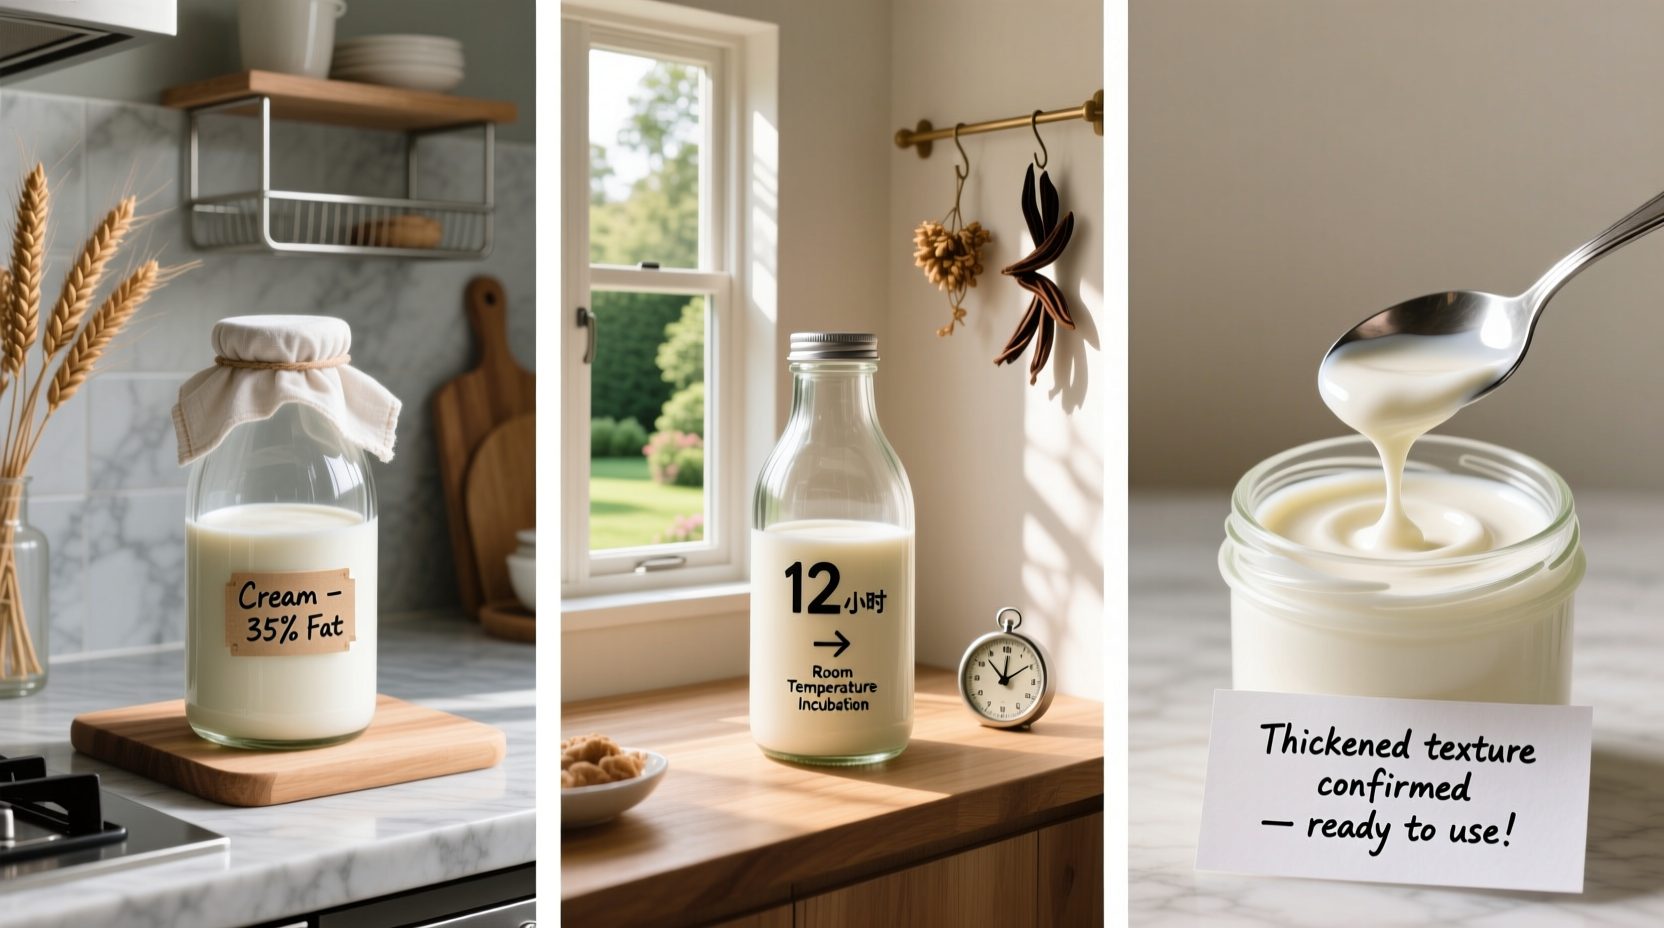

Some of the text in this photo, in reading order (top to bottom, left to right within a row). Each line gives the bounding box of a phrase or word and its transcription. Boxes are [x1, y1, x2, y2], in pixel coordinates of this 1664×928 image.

[238, 580, 318, 610] Cream
[246, 613, 344, 645] 35% Fat
[812, 664, 854, 679] Room
[786, 679, 878, 698] Temperature
[798, 696, 870, 712] Incubation
[1260, 722, 1537, 764] Thickened texture
[1317, 767, 1472, 804] confirmed
[1307, 809, 1391, 857] ready
[1404, 814, 1436, 842] to
[1449, 811, 1517, 847] use!
